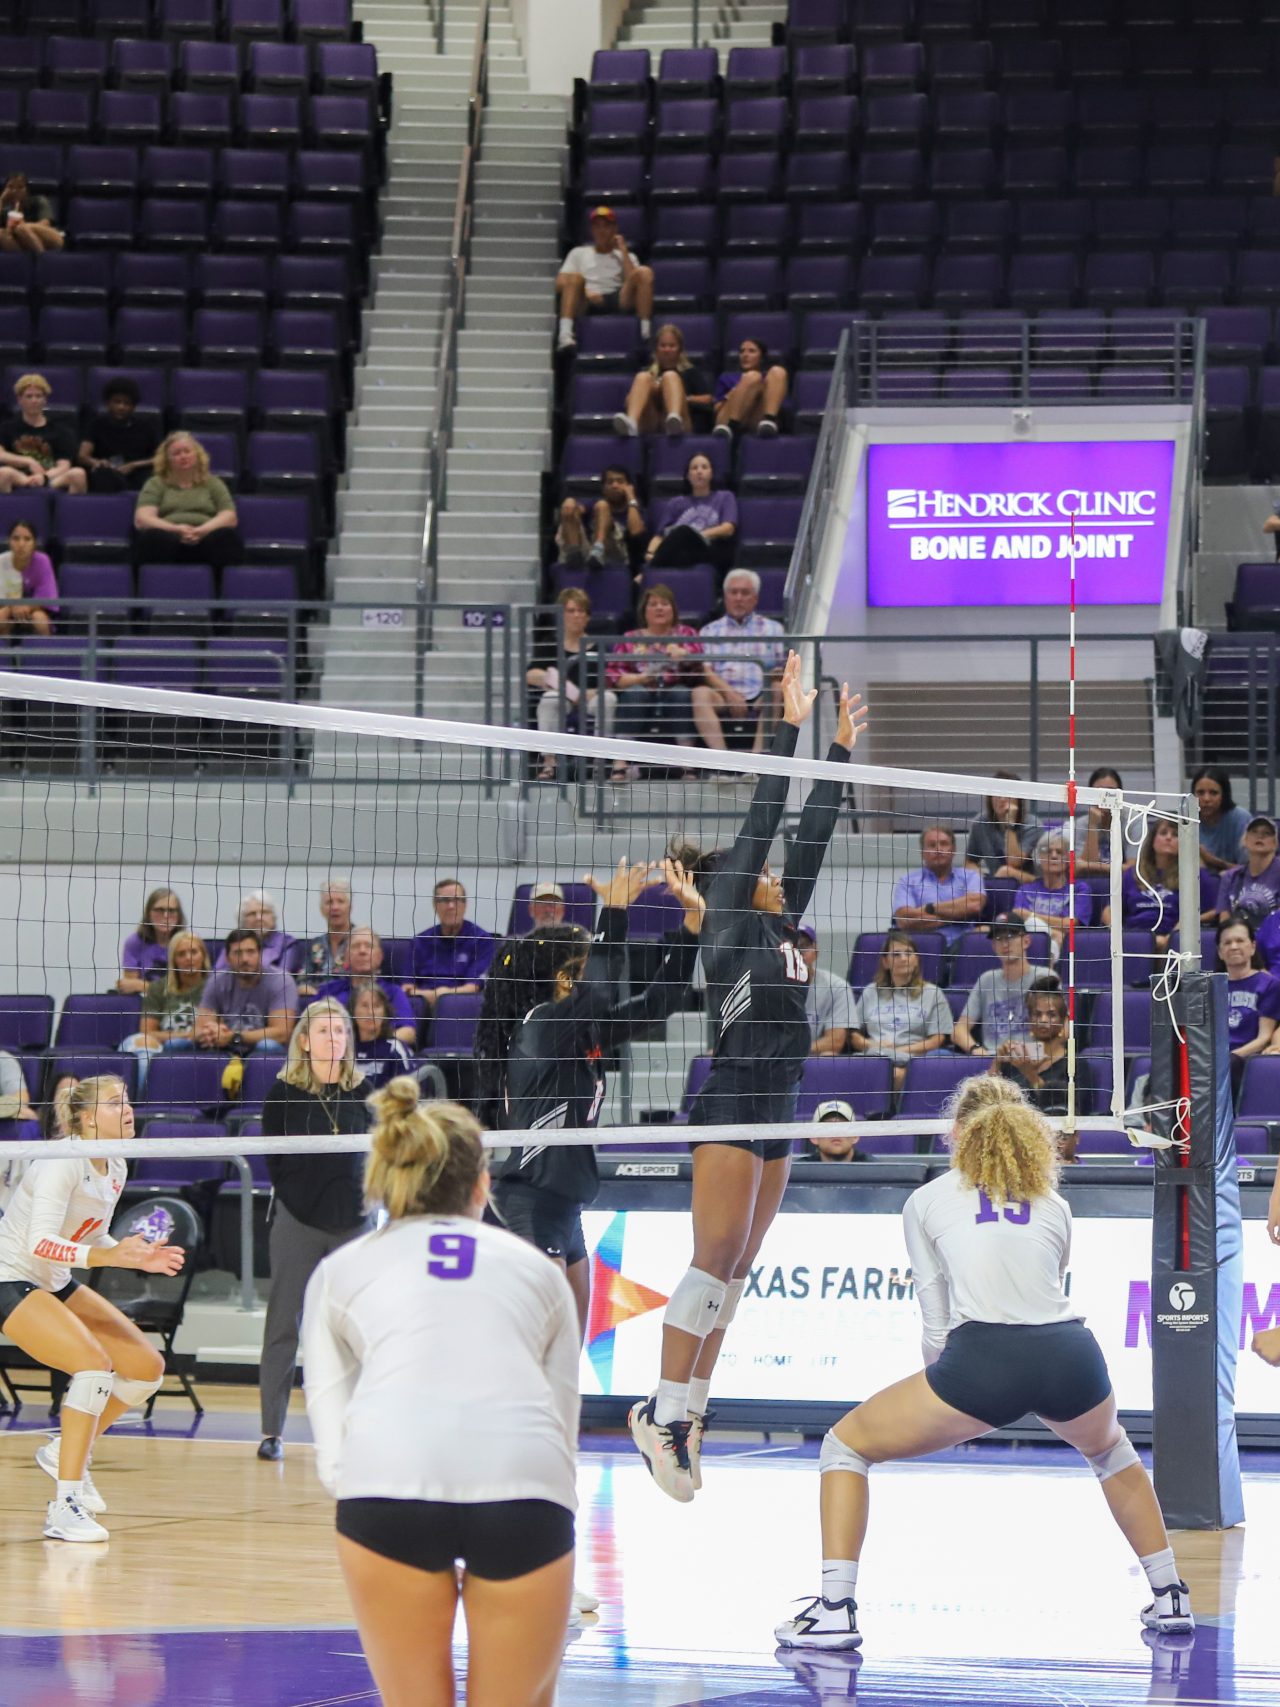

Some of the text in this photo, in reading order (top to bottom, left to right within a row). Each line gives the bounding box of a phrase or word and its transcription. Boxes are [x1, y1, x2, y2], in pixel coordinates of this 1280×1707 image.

[917, 490, 1156, 517] HENDRICK CLINIC
[910, 534, 1133, 560] BONE AND JOINT
[376, 612, 401, 625] 120
[465, 611, 486, 626] 10
[614, 1164, 676, 1176] ACE SPORTS
[428, 1233, 477, 1280] 9
[743, 1266, 915, 1301] XAS FARM
[1157, 1314, 1209, 1322] SPORTS IMPORTS
